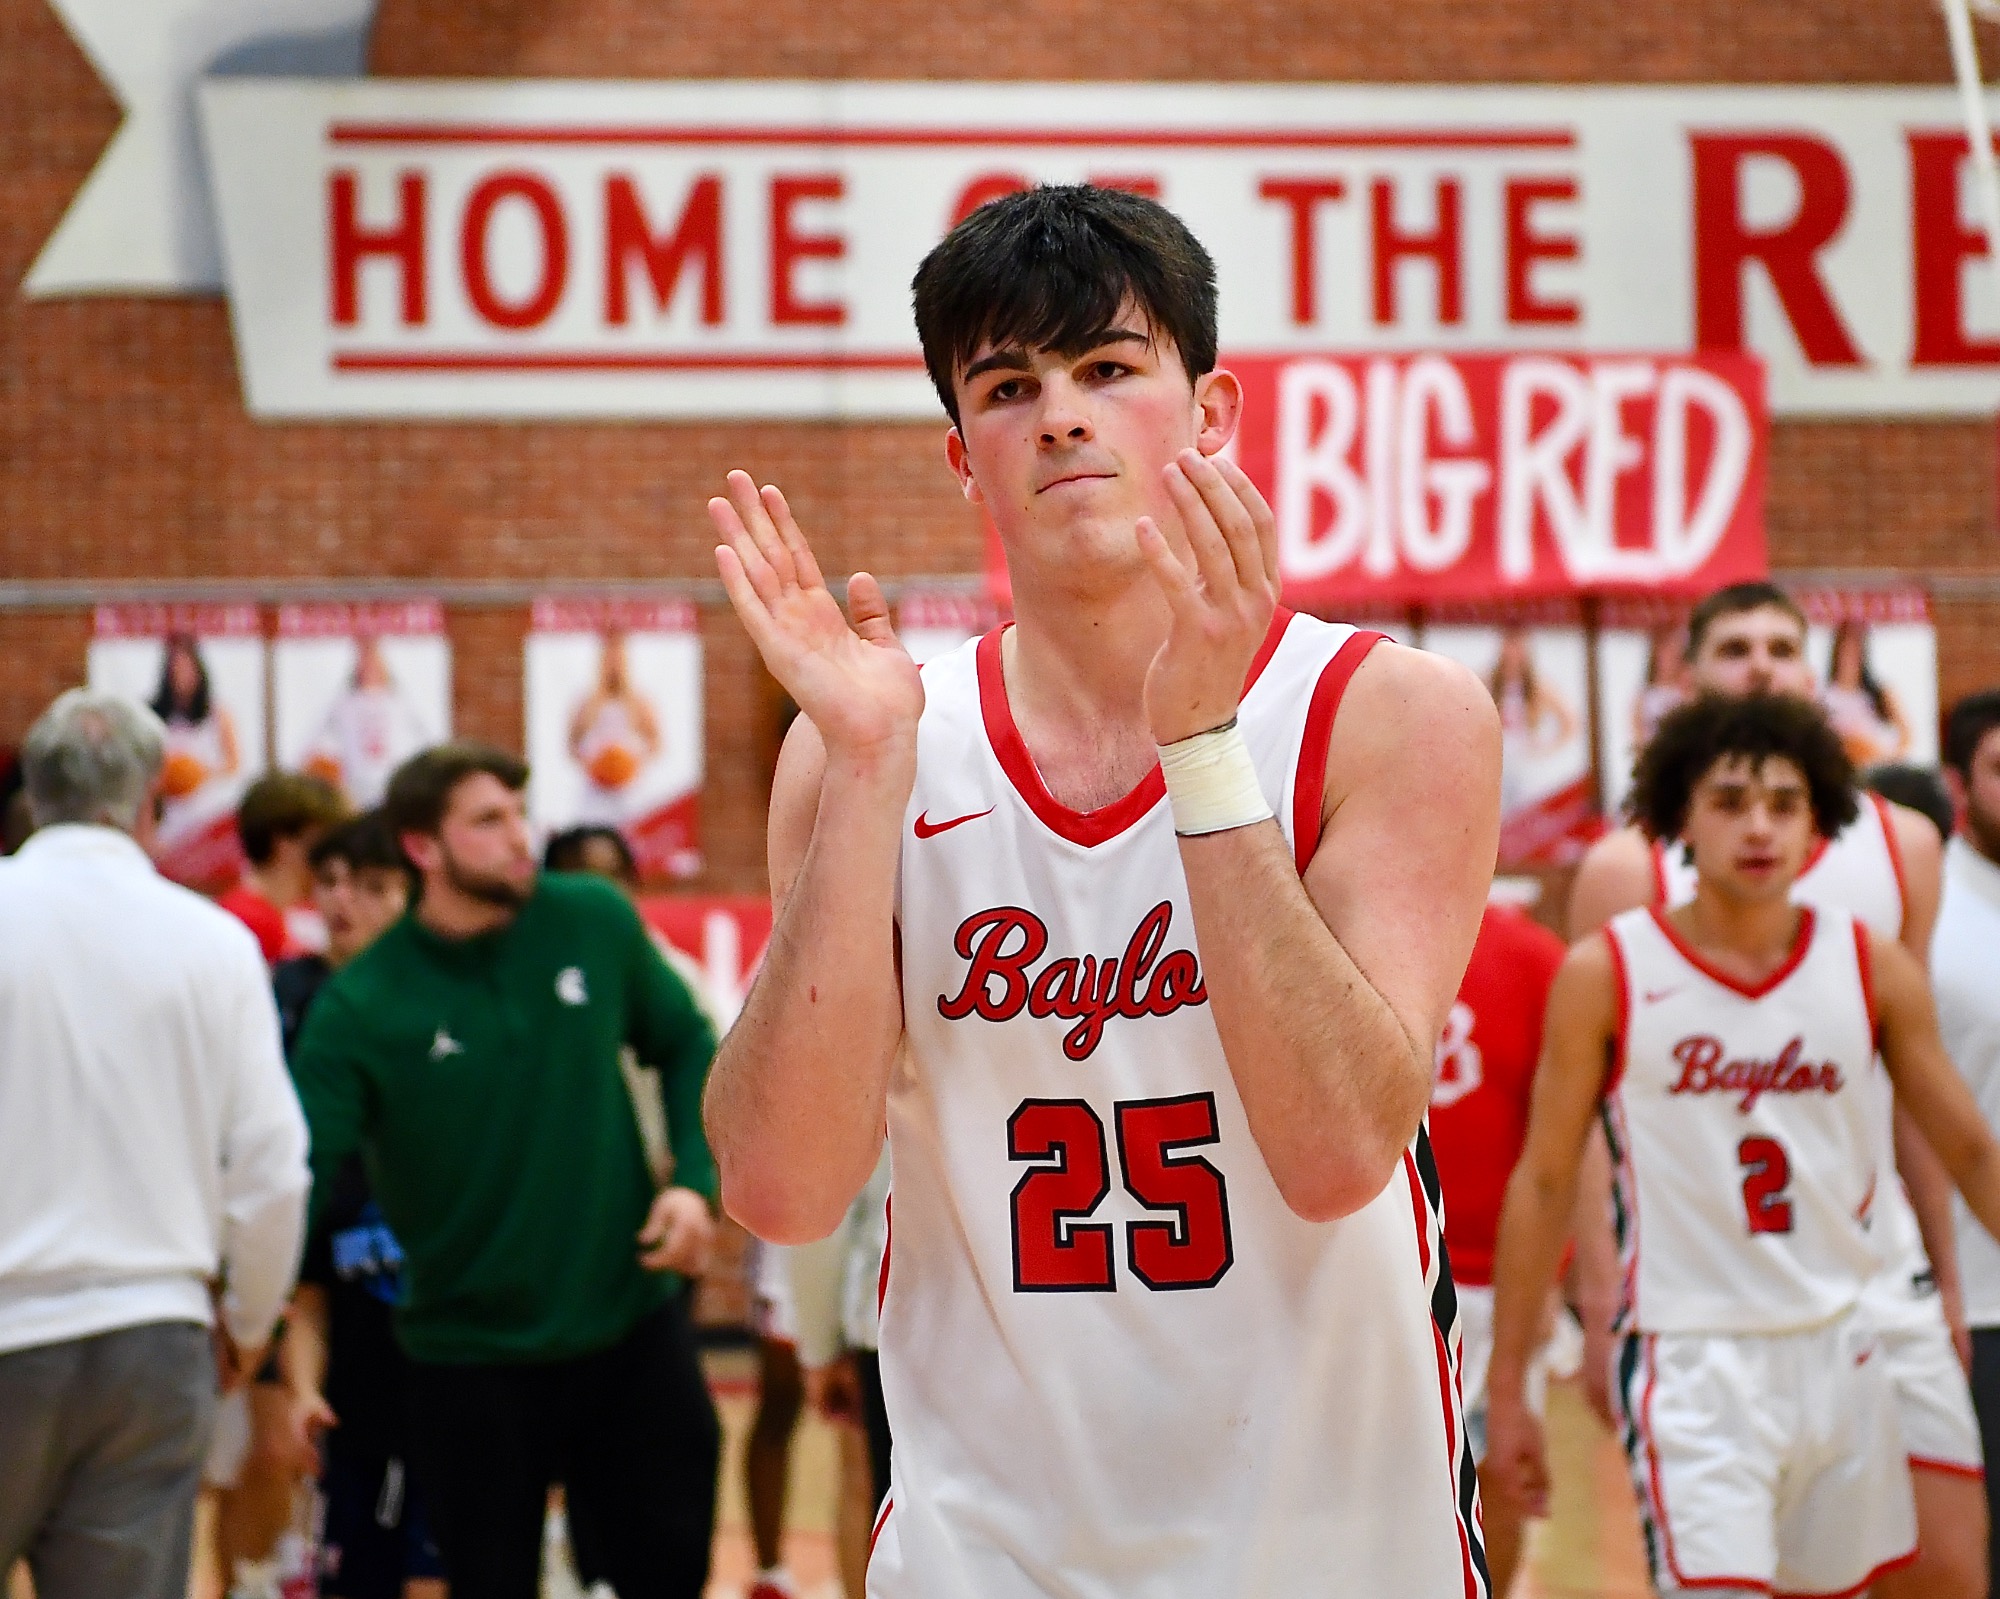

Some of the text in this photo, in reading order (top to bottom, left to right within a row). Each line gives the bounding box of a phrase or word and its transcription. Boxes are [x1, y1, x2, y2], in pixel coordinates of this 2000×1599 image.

[329, 170, 848, 330] HOME
[1257, 176, 1581, 327] THE
[1276, 358, 1753, 583] BIG RED
[937, 900, 1209, 1062] Baylo
[1668, 1033, 1844, 1116] Baylor
[1006, 1091, 1235, 1293] 25
[1737, 1133, 1794, 1236] 2
